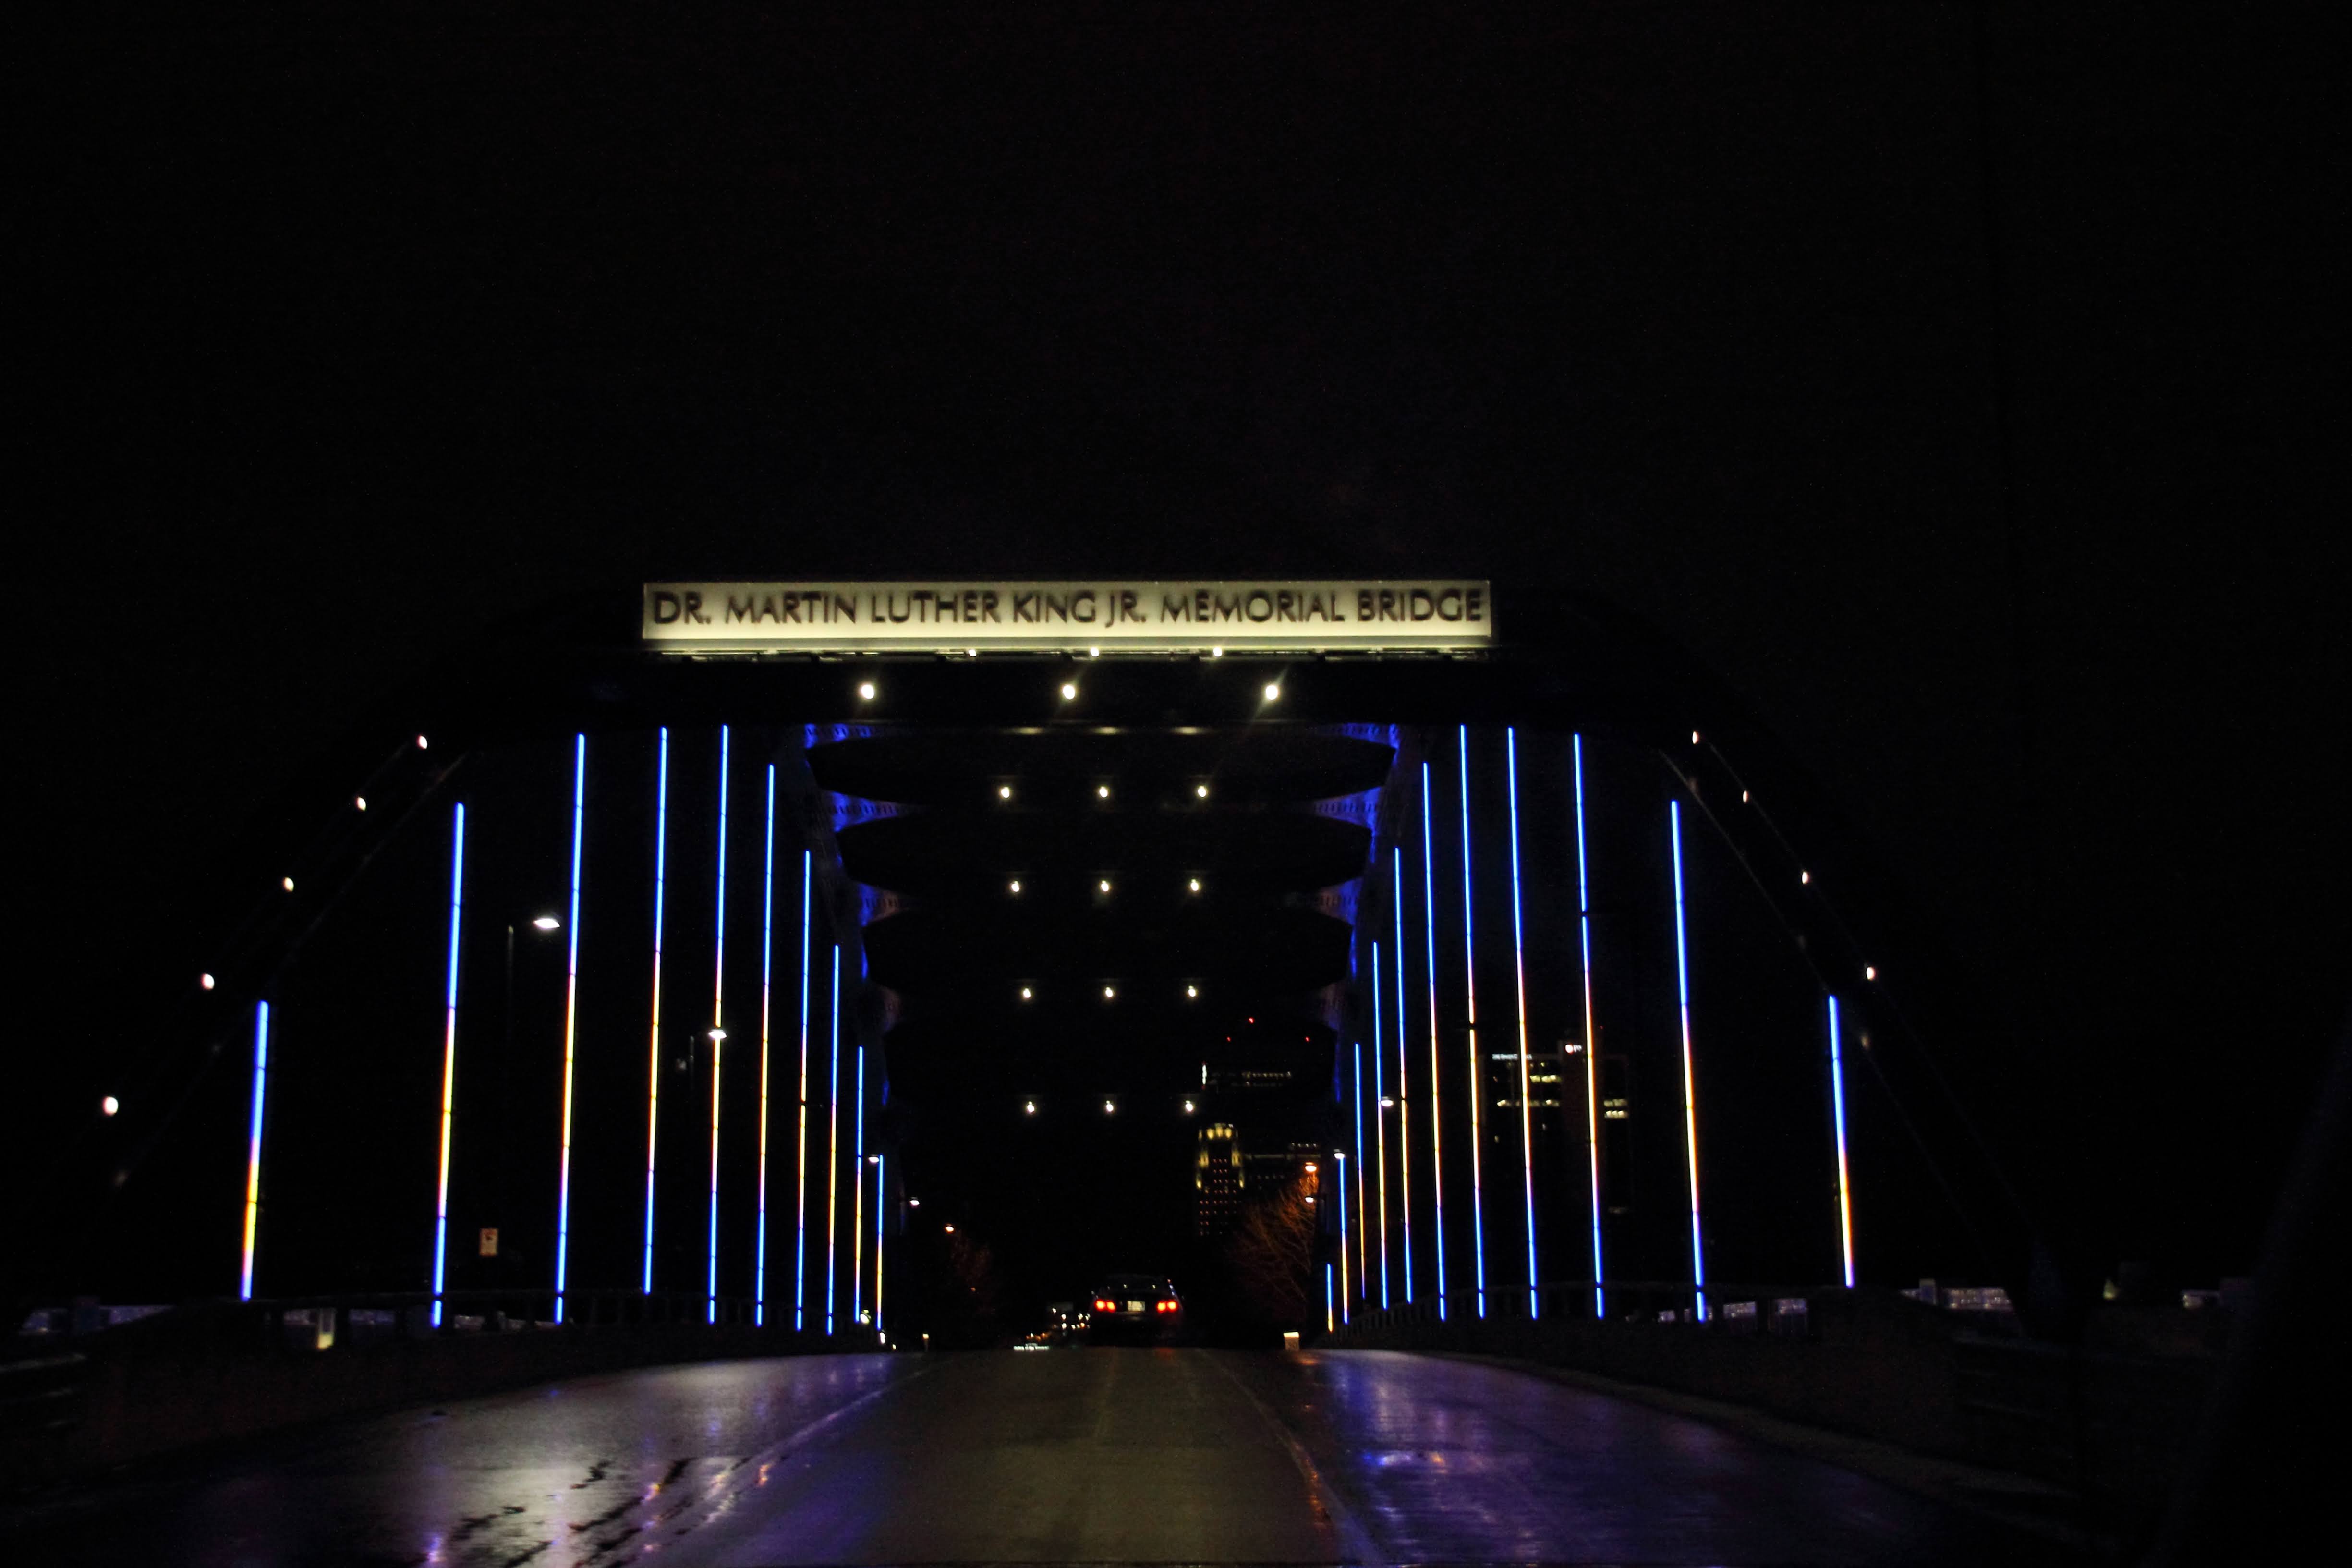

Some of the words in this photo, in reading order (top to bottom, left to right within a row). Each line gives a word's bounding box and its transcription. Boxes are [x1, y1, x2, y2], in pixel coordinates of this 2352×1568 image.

[655, 592, 711, 624] DR.
[724, 591, 857, 624] MARTIN
[871, 591, 1001, 624] LUTHER
[1013, 591, 1096, 624] KING
[1105, 590, 1147, 628] JR.
[1160, 590, 1345, 623] MEMORIAL
[1357, 589, 1482, 622] BRIDGE
